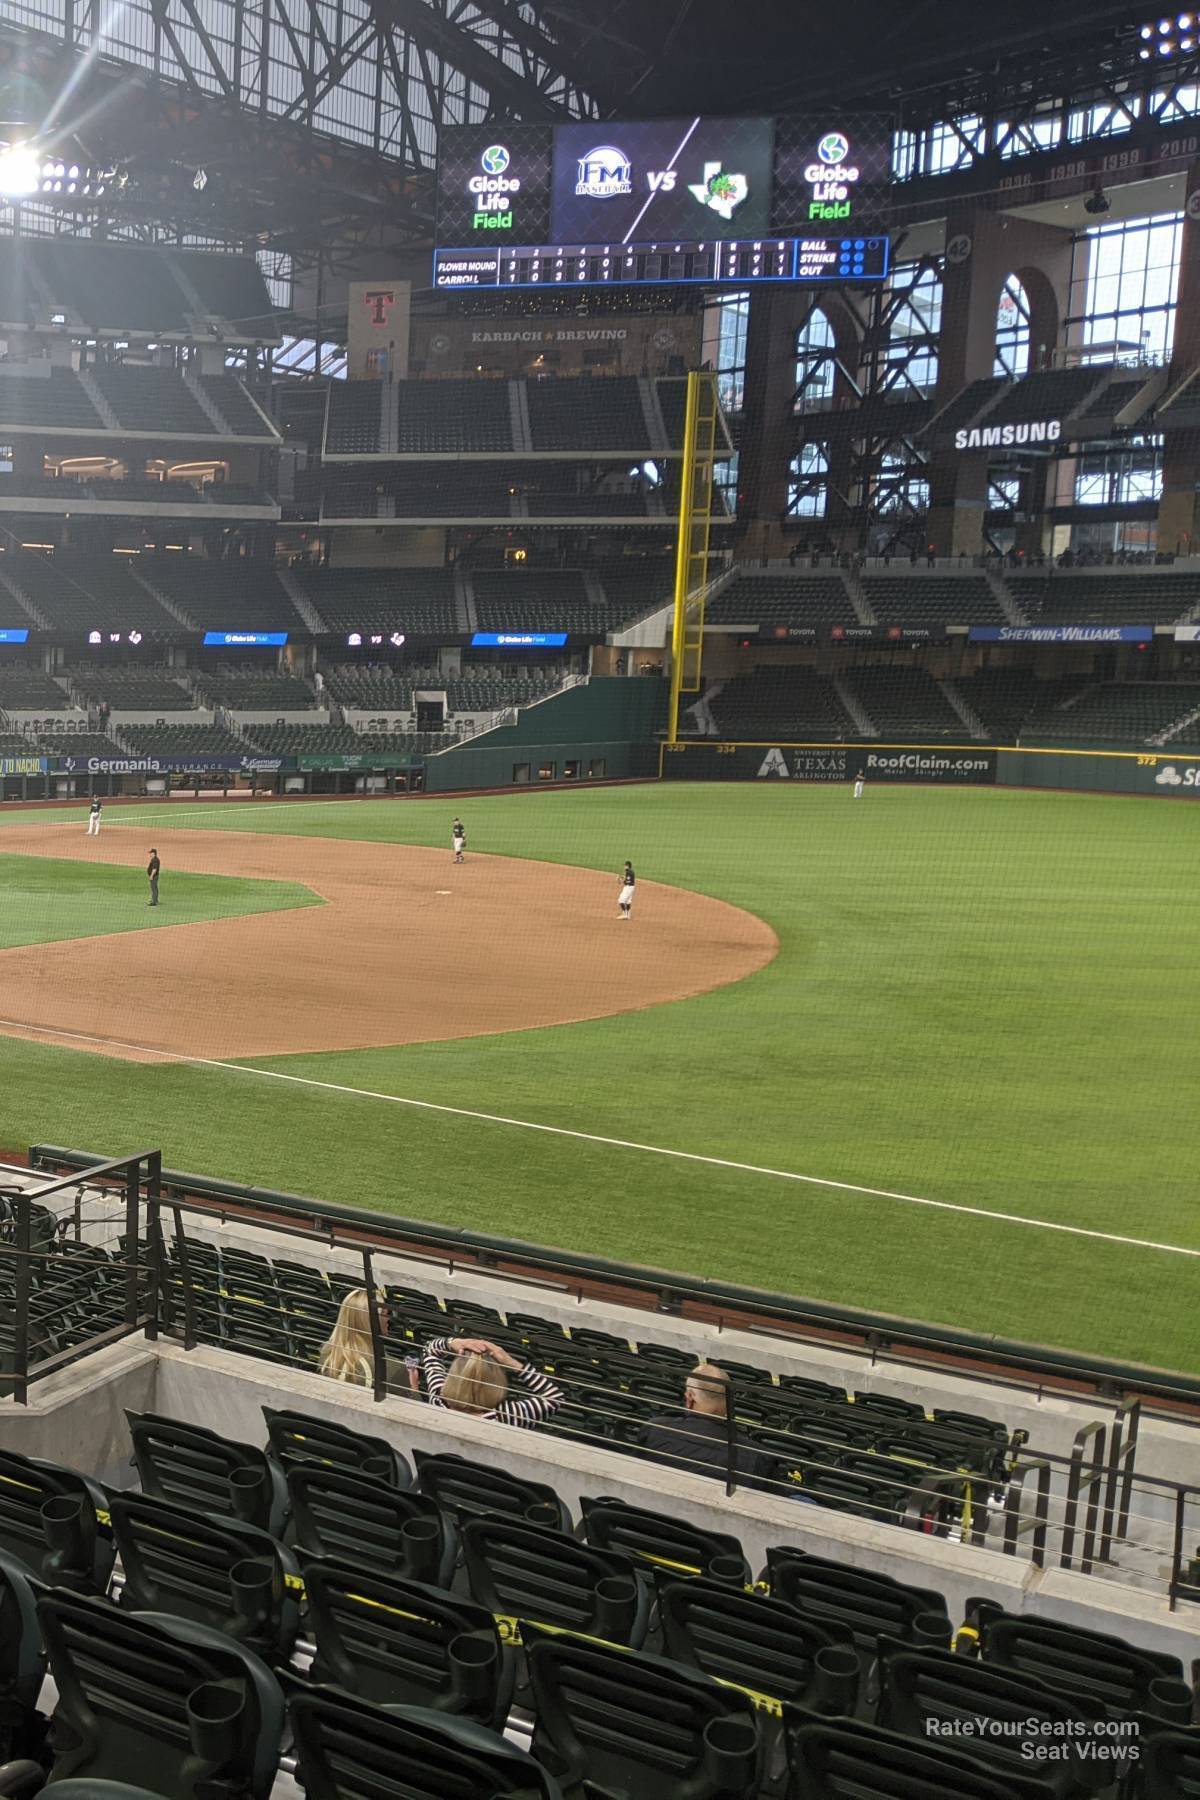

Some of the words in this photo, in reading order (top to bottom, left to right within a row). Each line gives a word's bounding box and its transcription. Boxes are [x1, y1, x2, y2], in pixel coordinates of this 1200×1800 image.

[1160, 137, 1197, 158] 2010
[1102, 149, 1139, 171] 1999
[804, 165, 859, 182] Globe
[1050, 161, 1086, 180] 1998
[469, 176, 520, 193] Globe
[813, 183, 848, 201] Life
[477, 194, 510, 211] Life
[808, 202, 850, 219] Field
[472, 212, 513, 229] Field
[627, 246, 633, 254] 6
[801, 241, 827, 251] BALL
[949, 241, 968, 257] 42
[438, 262, 467, 272] FLOWER
[469, 261, 496, 271] MOUND
[509, 261, 516, 270] 3
[532, 260, 539, 270] 2
[579, 259, 586, 268] 0
[602, 259, 609, 267] 0
[626, 257, 633, 266] 3
[753, 254, 760, 264] 9
[778, 254, 784, 263] 1
[800, 253, 837, 263] STRIKE
[438, 274, 479, 285] CARROLL
[509, 273, 516, 282] 1
[532, 272, 539, 281] 0
[555, 272, 562, 281] 3
[578, 271, 585, 280] 0
[602, 270, 609, 279] 1
[728, 267, 736, 276] 5
[752, 266, 759, 276] 6
[778, 266, 784, 276] 1
[800, 266, 823, 275] OUT
[472, 332, 542, 343] KARBACH
[557, 330, 627, 340] BREWING
[955, 421, 1060, 449] SAMSUNG
[903, 629, 929, 637] TOYOTA
[5, 759, 14, 773] TO
[88, 757, 160, 771] Germania
[794, 759, 847, 770] TEXAS
[867, 754, 989, 770] RoofClaim.com
[1137, 756, 1157, 766] 372
[793, 771, 846, 779] ARLINGTON
[915, 769, 944, 777] Shingle
